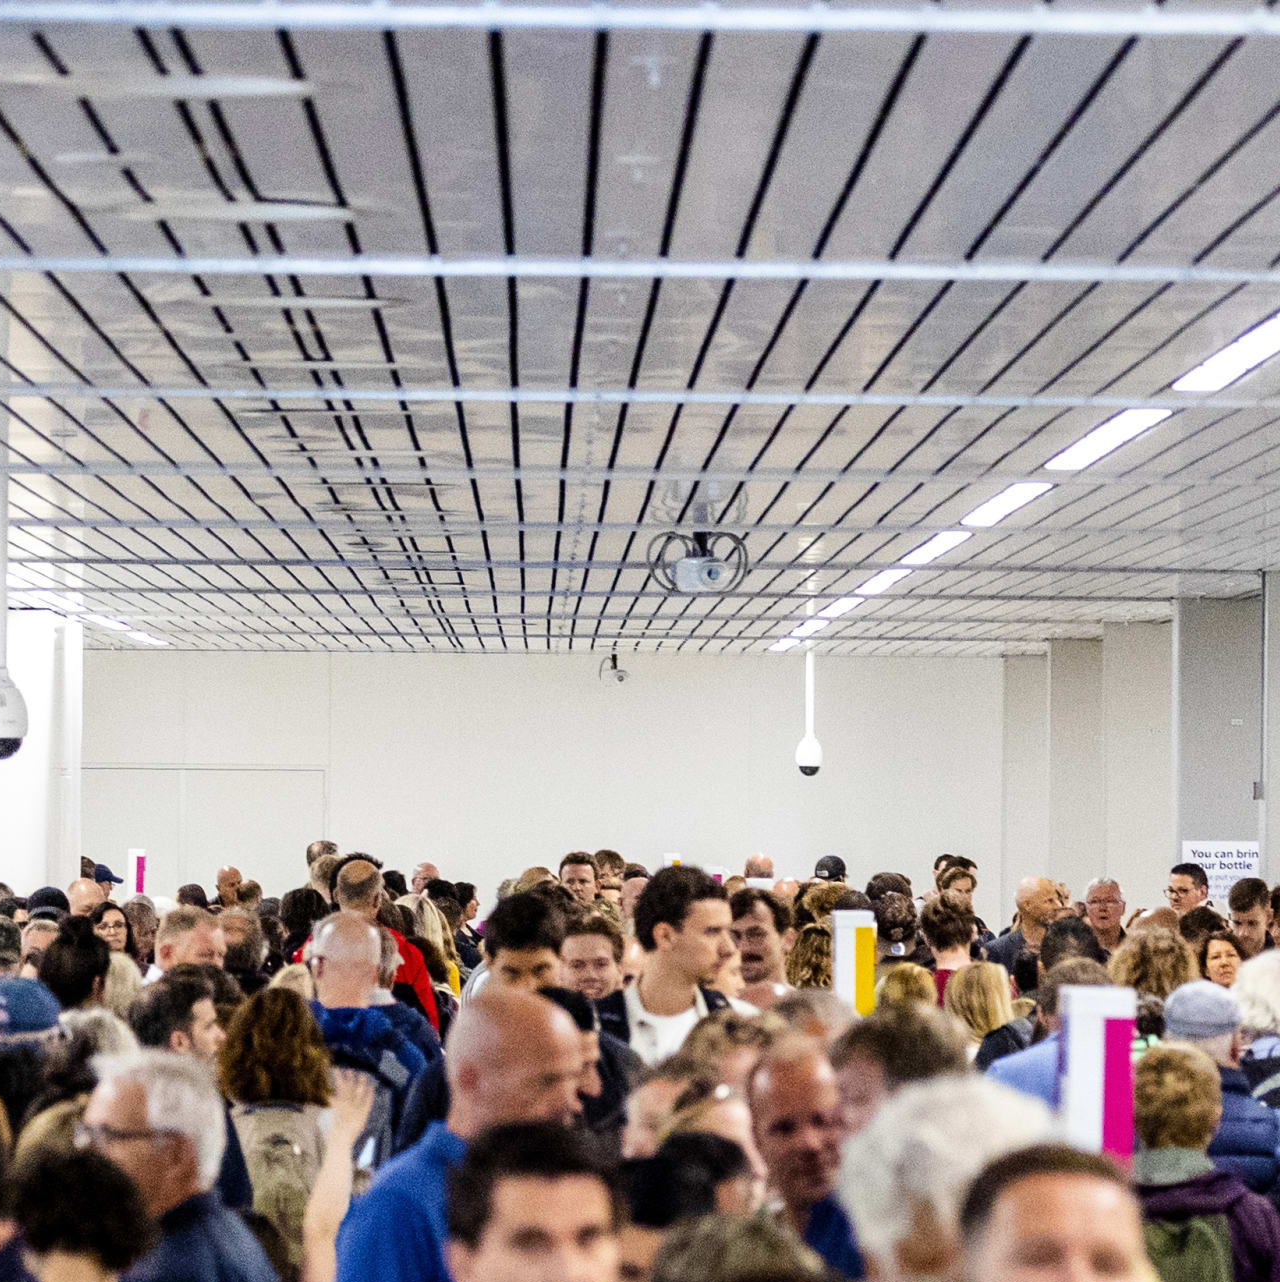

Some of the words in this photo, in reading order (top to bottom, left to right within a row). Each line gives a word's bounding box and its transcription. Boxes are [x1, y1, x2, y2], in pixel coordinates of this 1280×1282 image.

[1191, 849, 1212, 858] You
[1214, 850, 1233, 858] can
[1219, 861, 1253, 870] bottle
